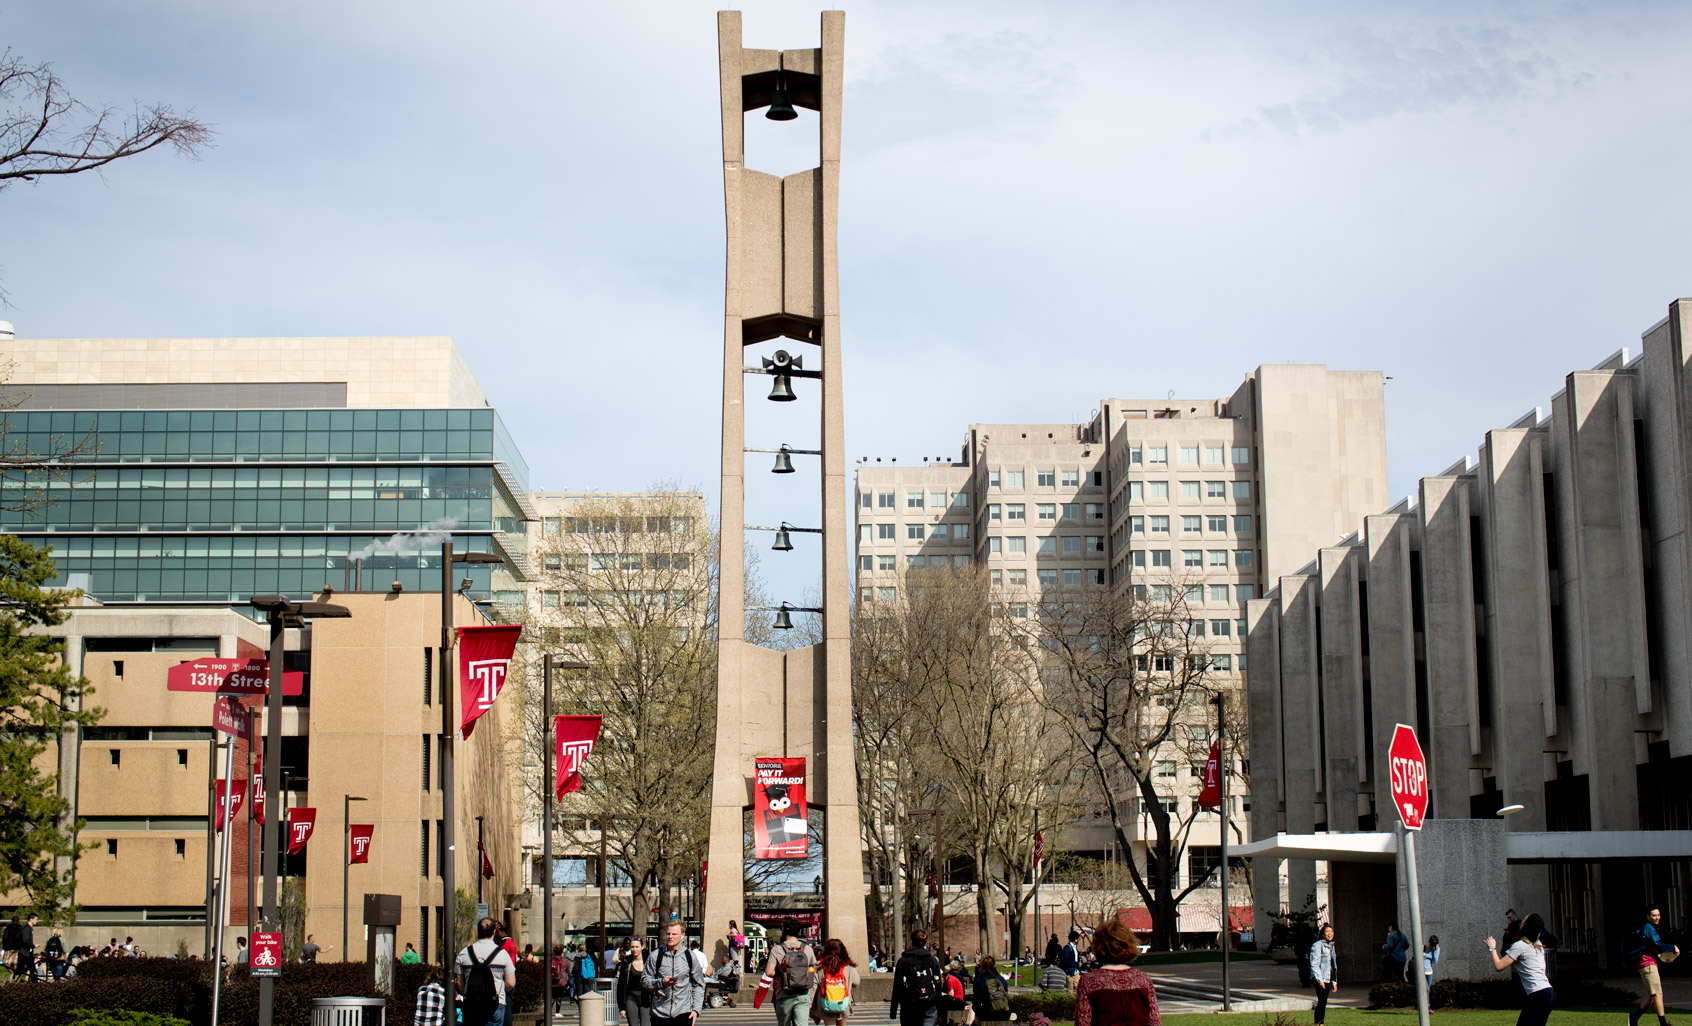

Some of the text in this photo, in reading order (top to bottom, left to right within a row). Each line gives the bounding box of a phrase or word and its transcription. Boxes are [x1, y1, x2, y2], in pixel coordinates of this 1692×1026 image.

[190, 672, 270, 688] 13th Stree
[757, 769, 784, 777] PAY IT
[1392, 756, 1424, 797] STOP
[757, 777, 804, 785] FORWARD!
